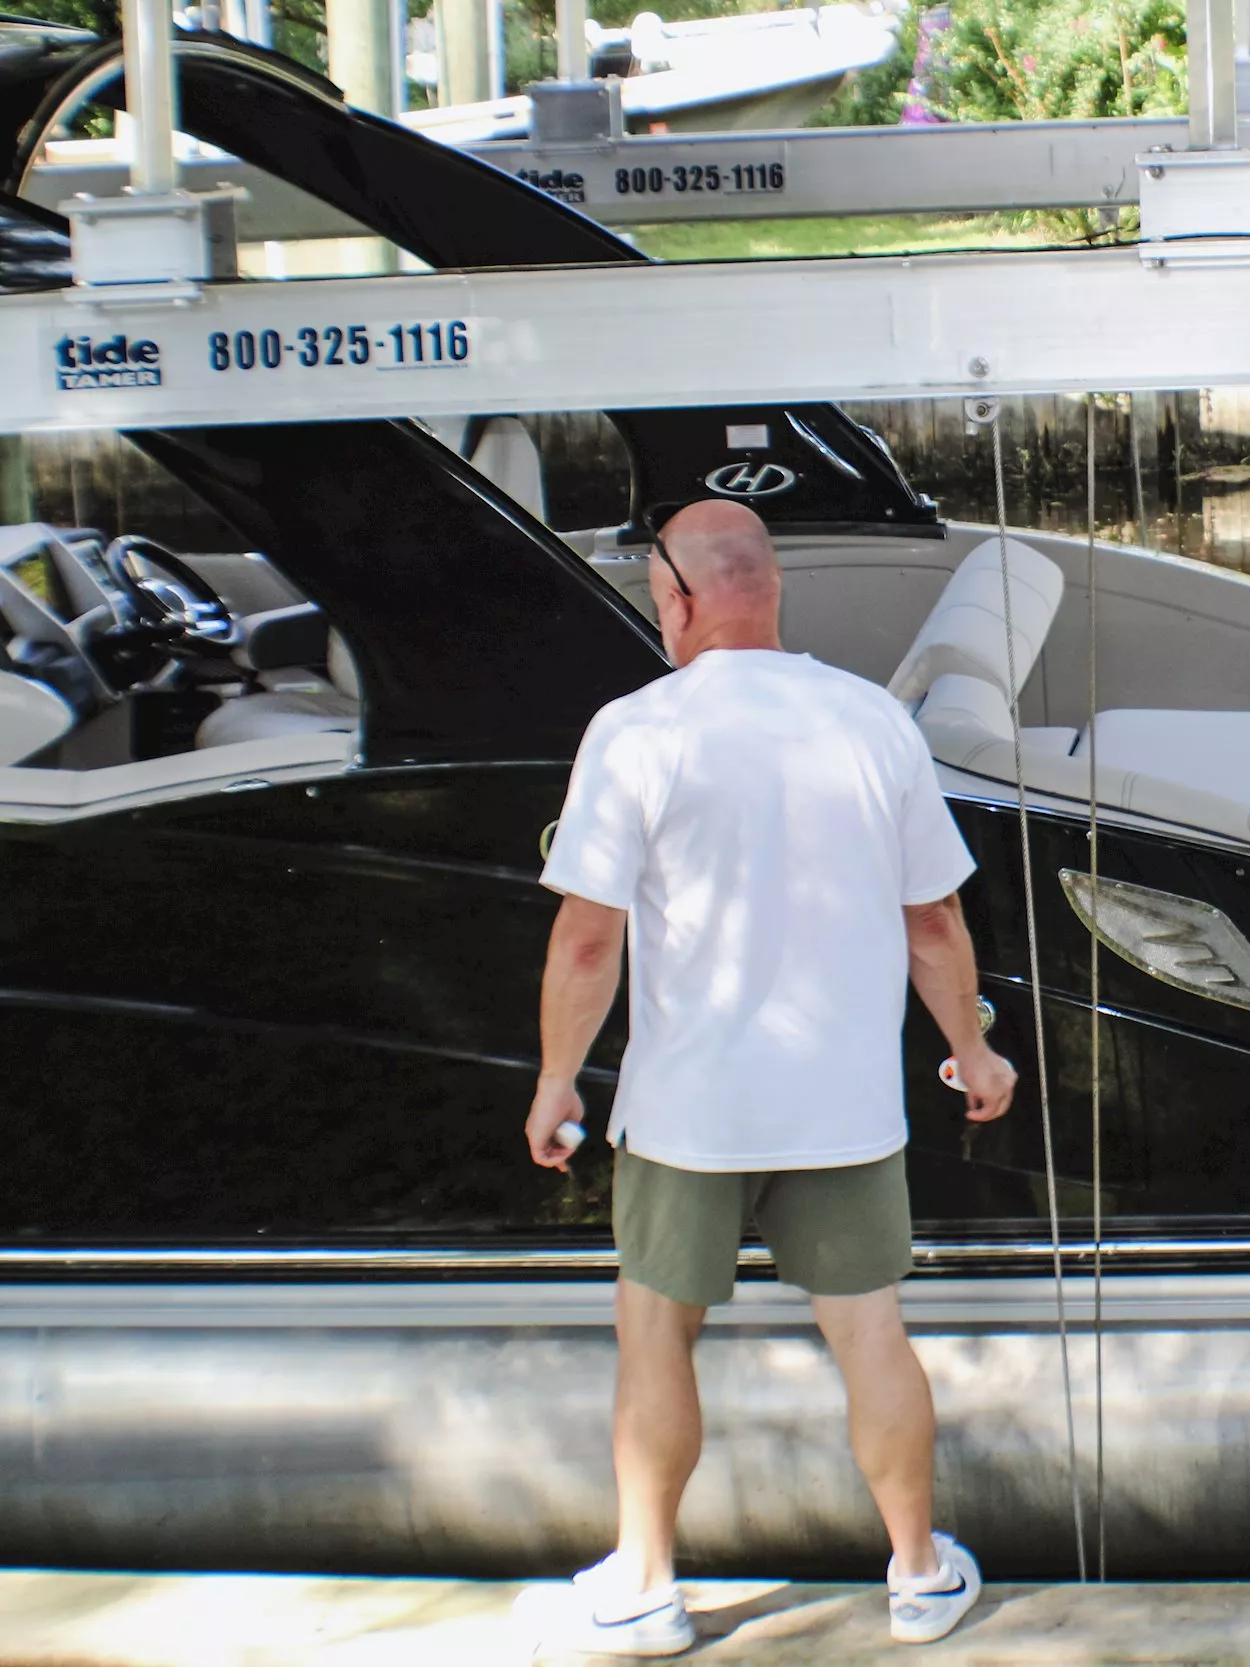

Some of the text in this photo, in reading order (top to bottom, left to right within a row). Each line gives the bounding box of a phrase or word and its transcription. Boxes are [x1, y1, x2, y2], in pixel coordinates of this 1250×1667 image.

[615, 162, 784, 194] 800-325-1116
[53, 333, 160, 368] tide
[208, 320, 469, 371] 800-325-1116
[60, 368, 160, 389] TAMER
